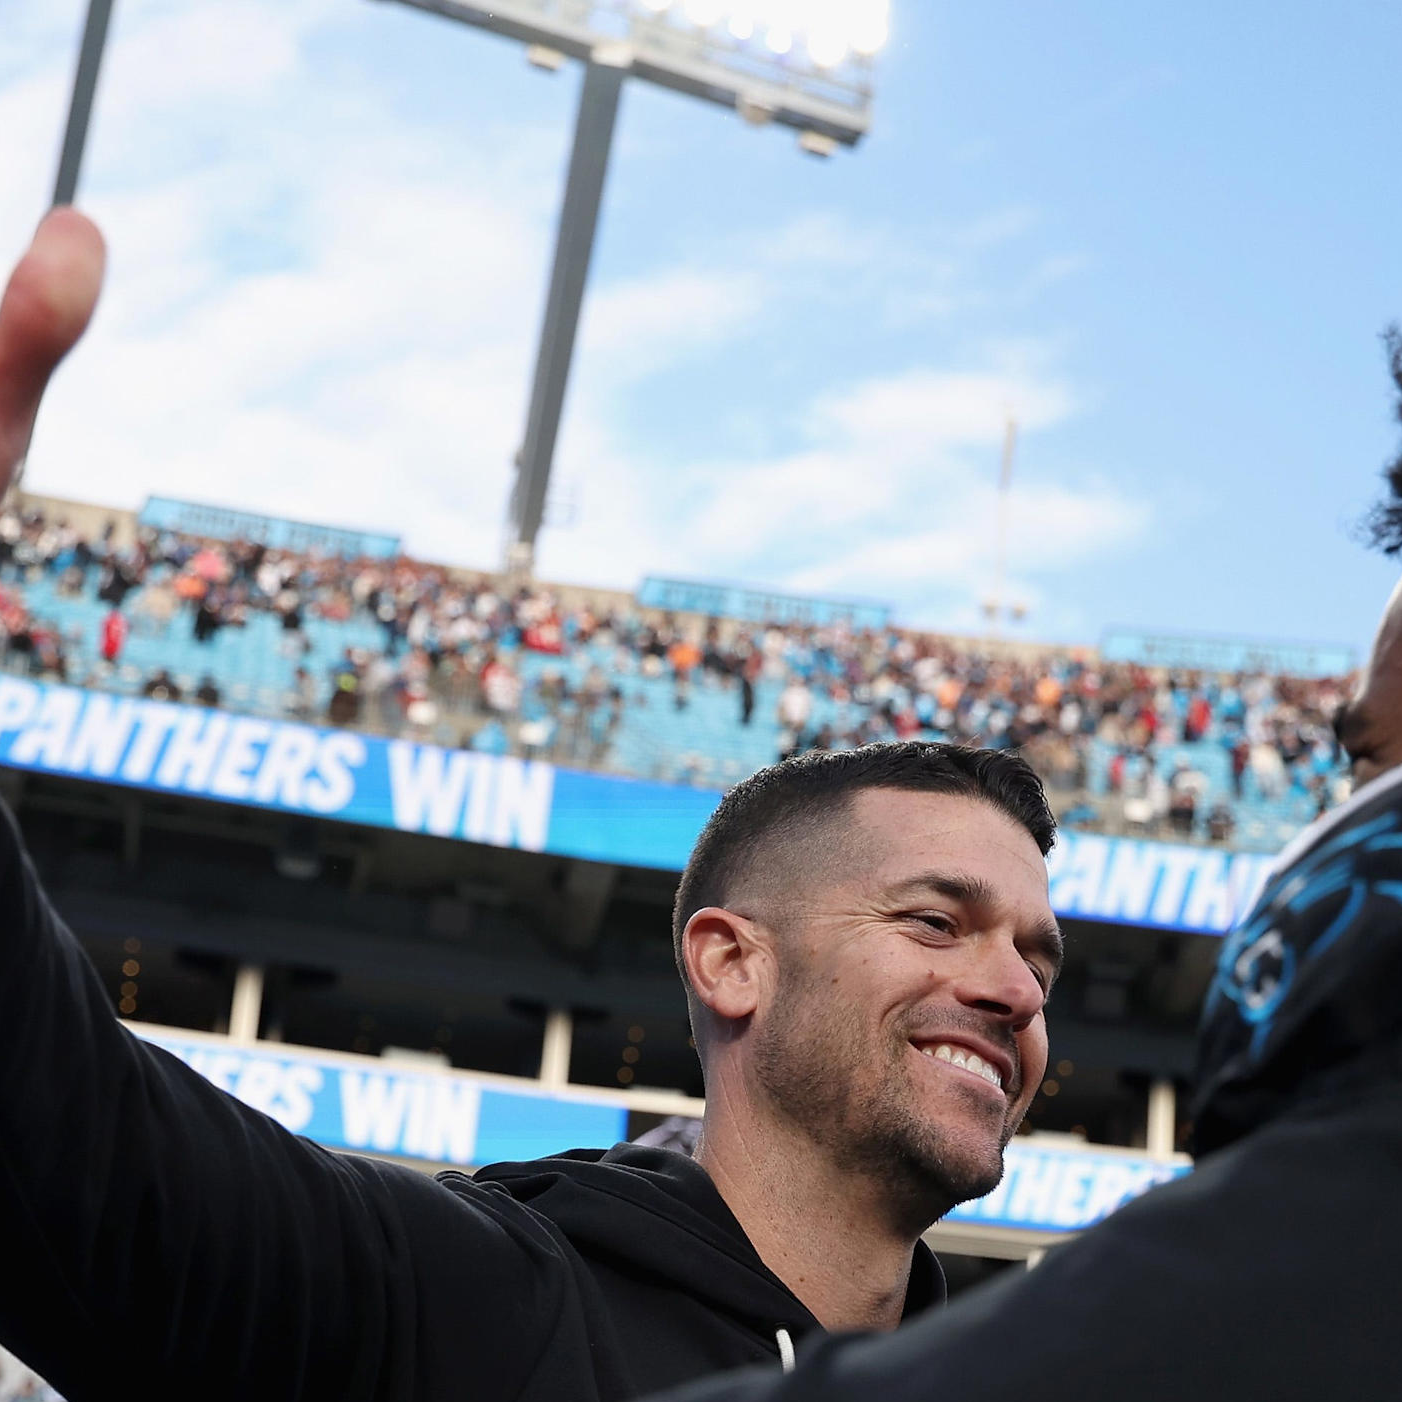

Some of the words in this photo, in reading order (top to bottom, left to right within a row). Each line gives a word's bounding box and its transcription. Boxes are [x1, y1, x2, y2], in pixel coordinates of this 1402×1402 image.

[387, 740, 556, 853] WIN
[1048, 831, 1278, 930] ANTH
[338, 1069, 483, 1165] WIN
